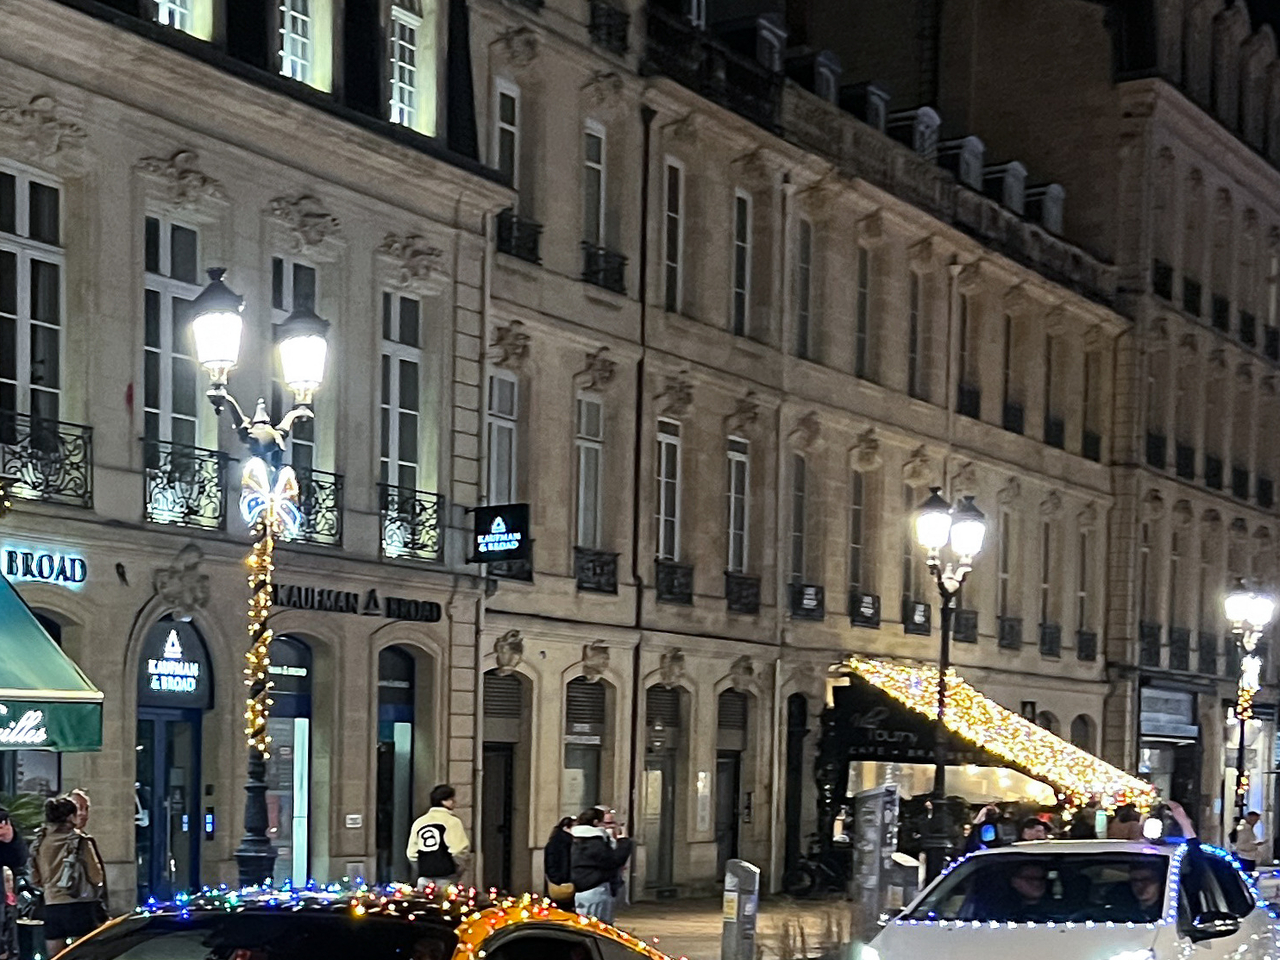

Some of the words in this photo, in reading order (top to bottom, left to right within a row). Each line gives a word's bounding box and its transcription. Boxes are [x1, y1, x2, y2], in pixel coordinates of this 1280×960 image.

[4, 549, 88, 583] BROAD
[271, 583, 360, 615] KAUFMAN
[384, 597, 442, 623] BROAD
[148, 658, 199, 677] KAUFMAN
[150, 674, 161, 690] &
[161, 675, 197, 692] BROAD
